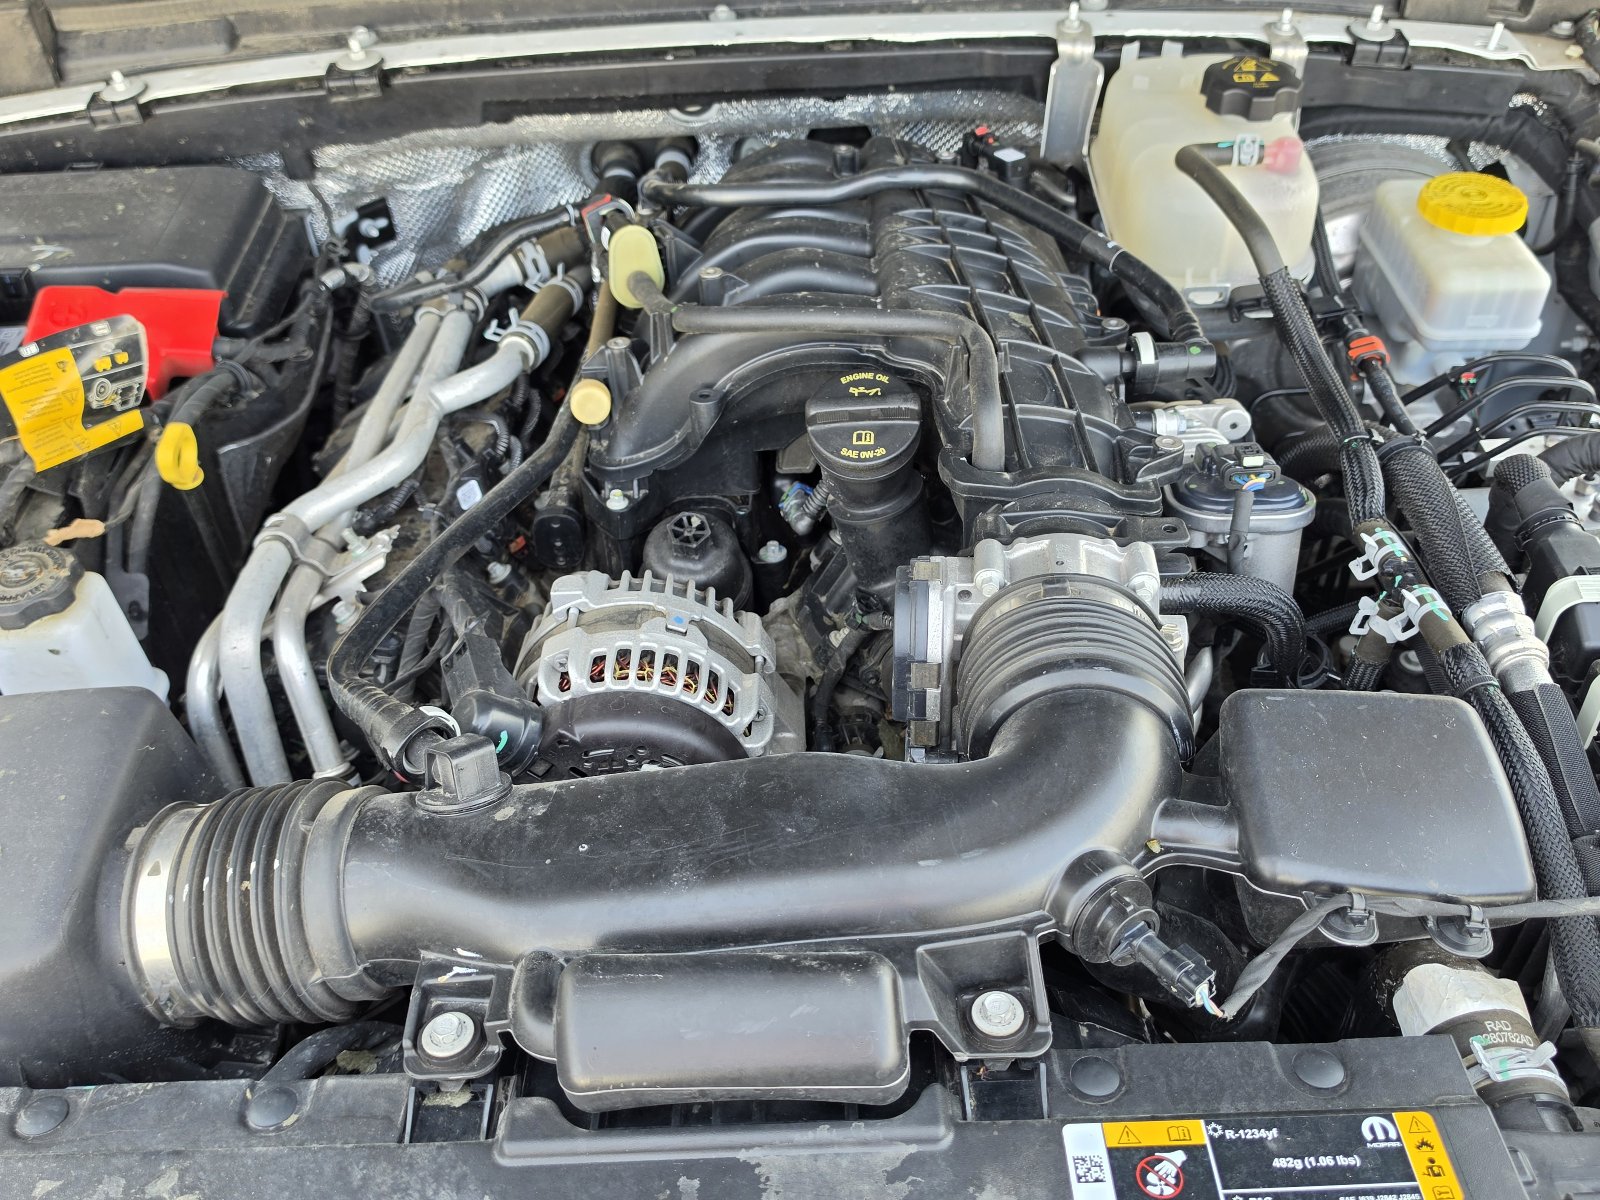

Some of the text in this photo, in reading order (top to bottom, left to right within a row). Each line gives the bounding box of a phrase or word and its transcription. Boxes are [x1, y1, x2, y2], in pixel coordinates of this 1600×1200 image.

[840, 372, 890, 385] ENGINE OIL
[840, 447, 887, 459] SAE 0W-20
[1484, 1020, 1512, 1032] RAD
[1224, 1127, 1279, 1141] R-1234yf
[1272, 1155, 1362, 1170] 482g (1.06 lbs)
